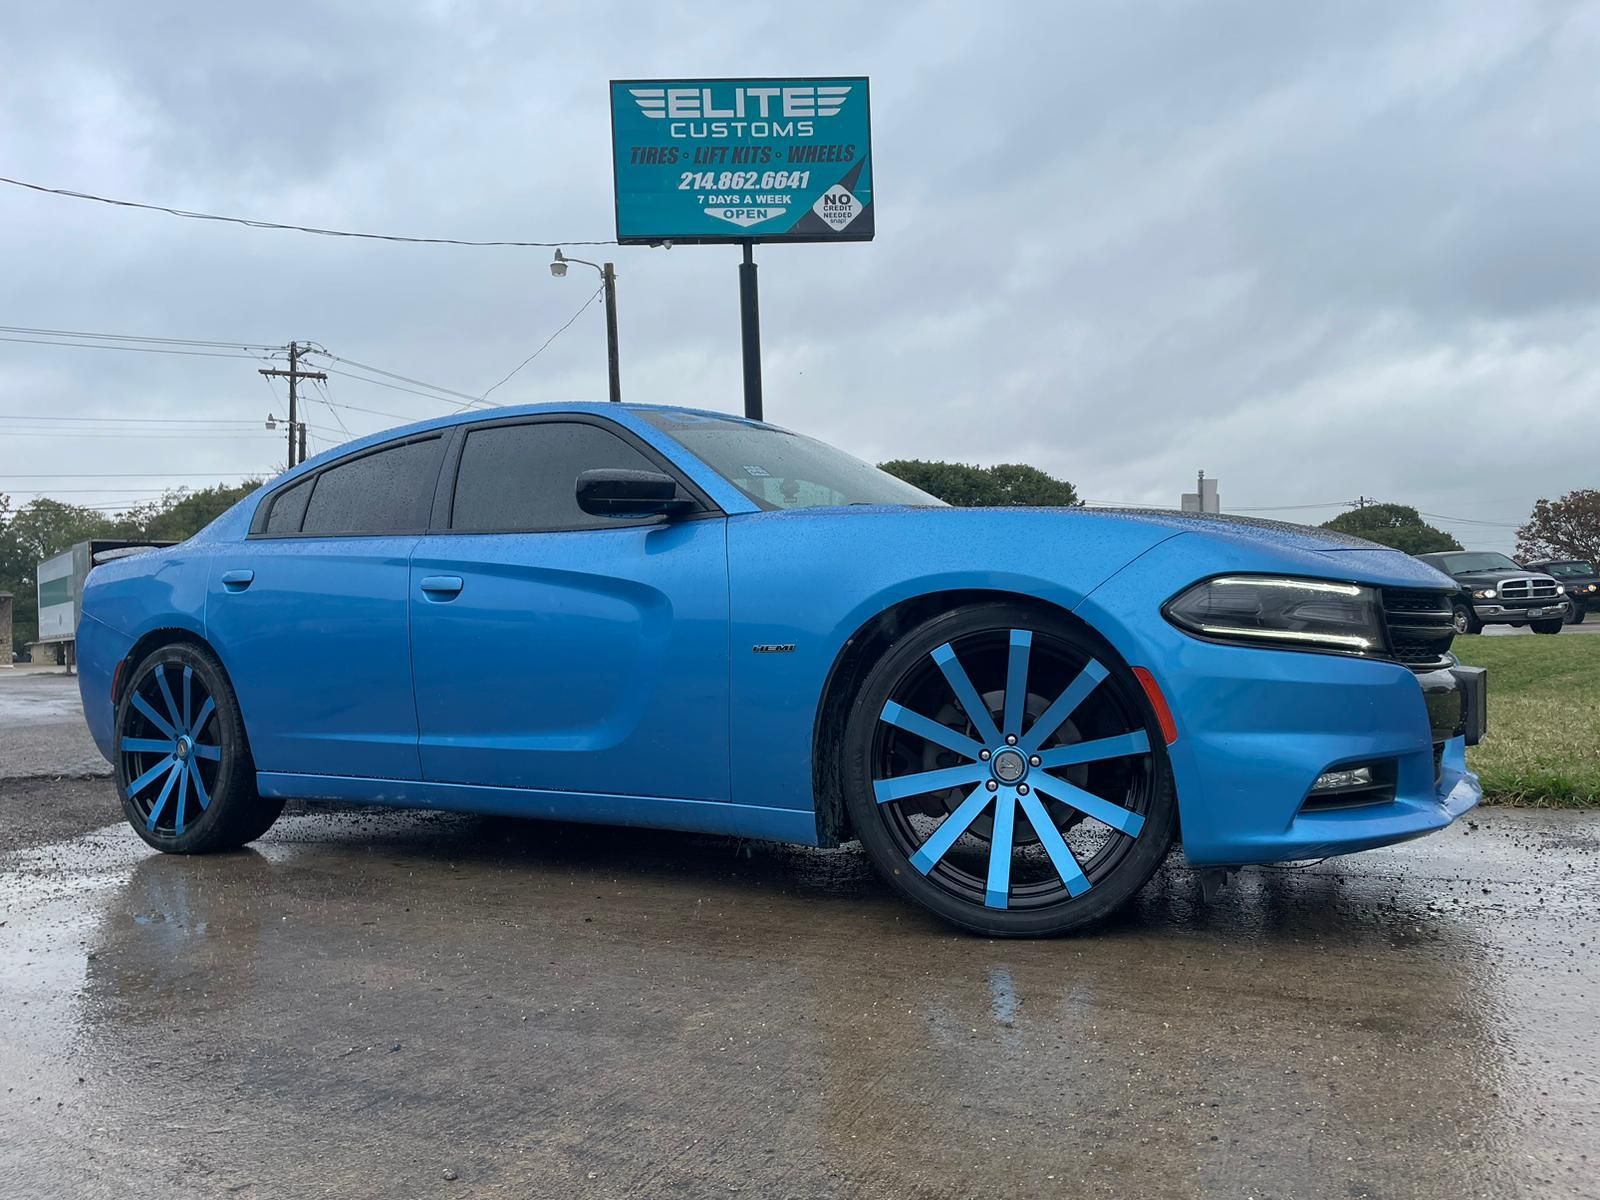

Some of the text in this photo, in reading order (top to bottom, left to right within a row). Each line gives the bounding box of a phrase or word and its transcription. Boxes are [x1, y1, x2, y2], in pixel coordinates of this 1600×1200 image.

[667, 87, 815, 118] ELITE
[670, 121, 814, 138] CUSTOMS
[630, 144, 856, 165] TIRES LIFT KITS WHEELS
[678, 171, 810, 190] 214.862.6641
[697, 194, 792, 204] 7 DAYS A WEEK
[824, 193, 851, 205] NO
[723, 209, 768, 219] OPEN
[752, 644, 796, 653] HEMI
